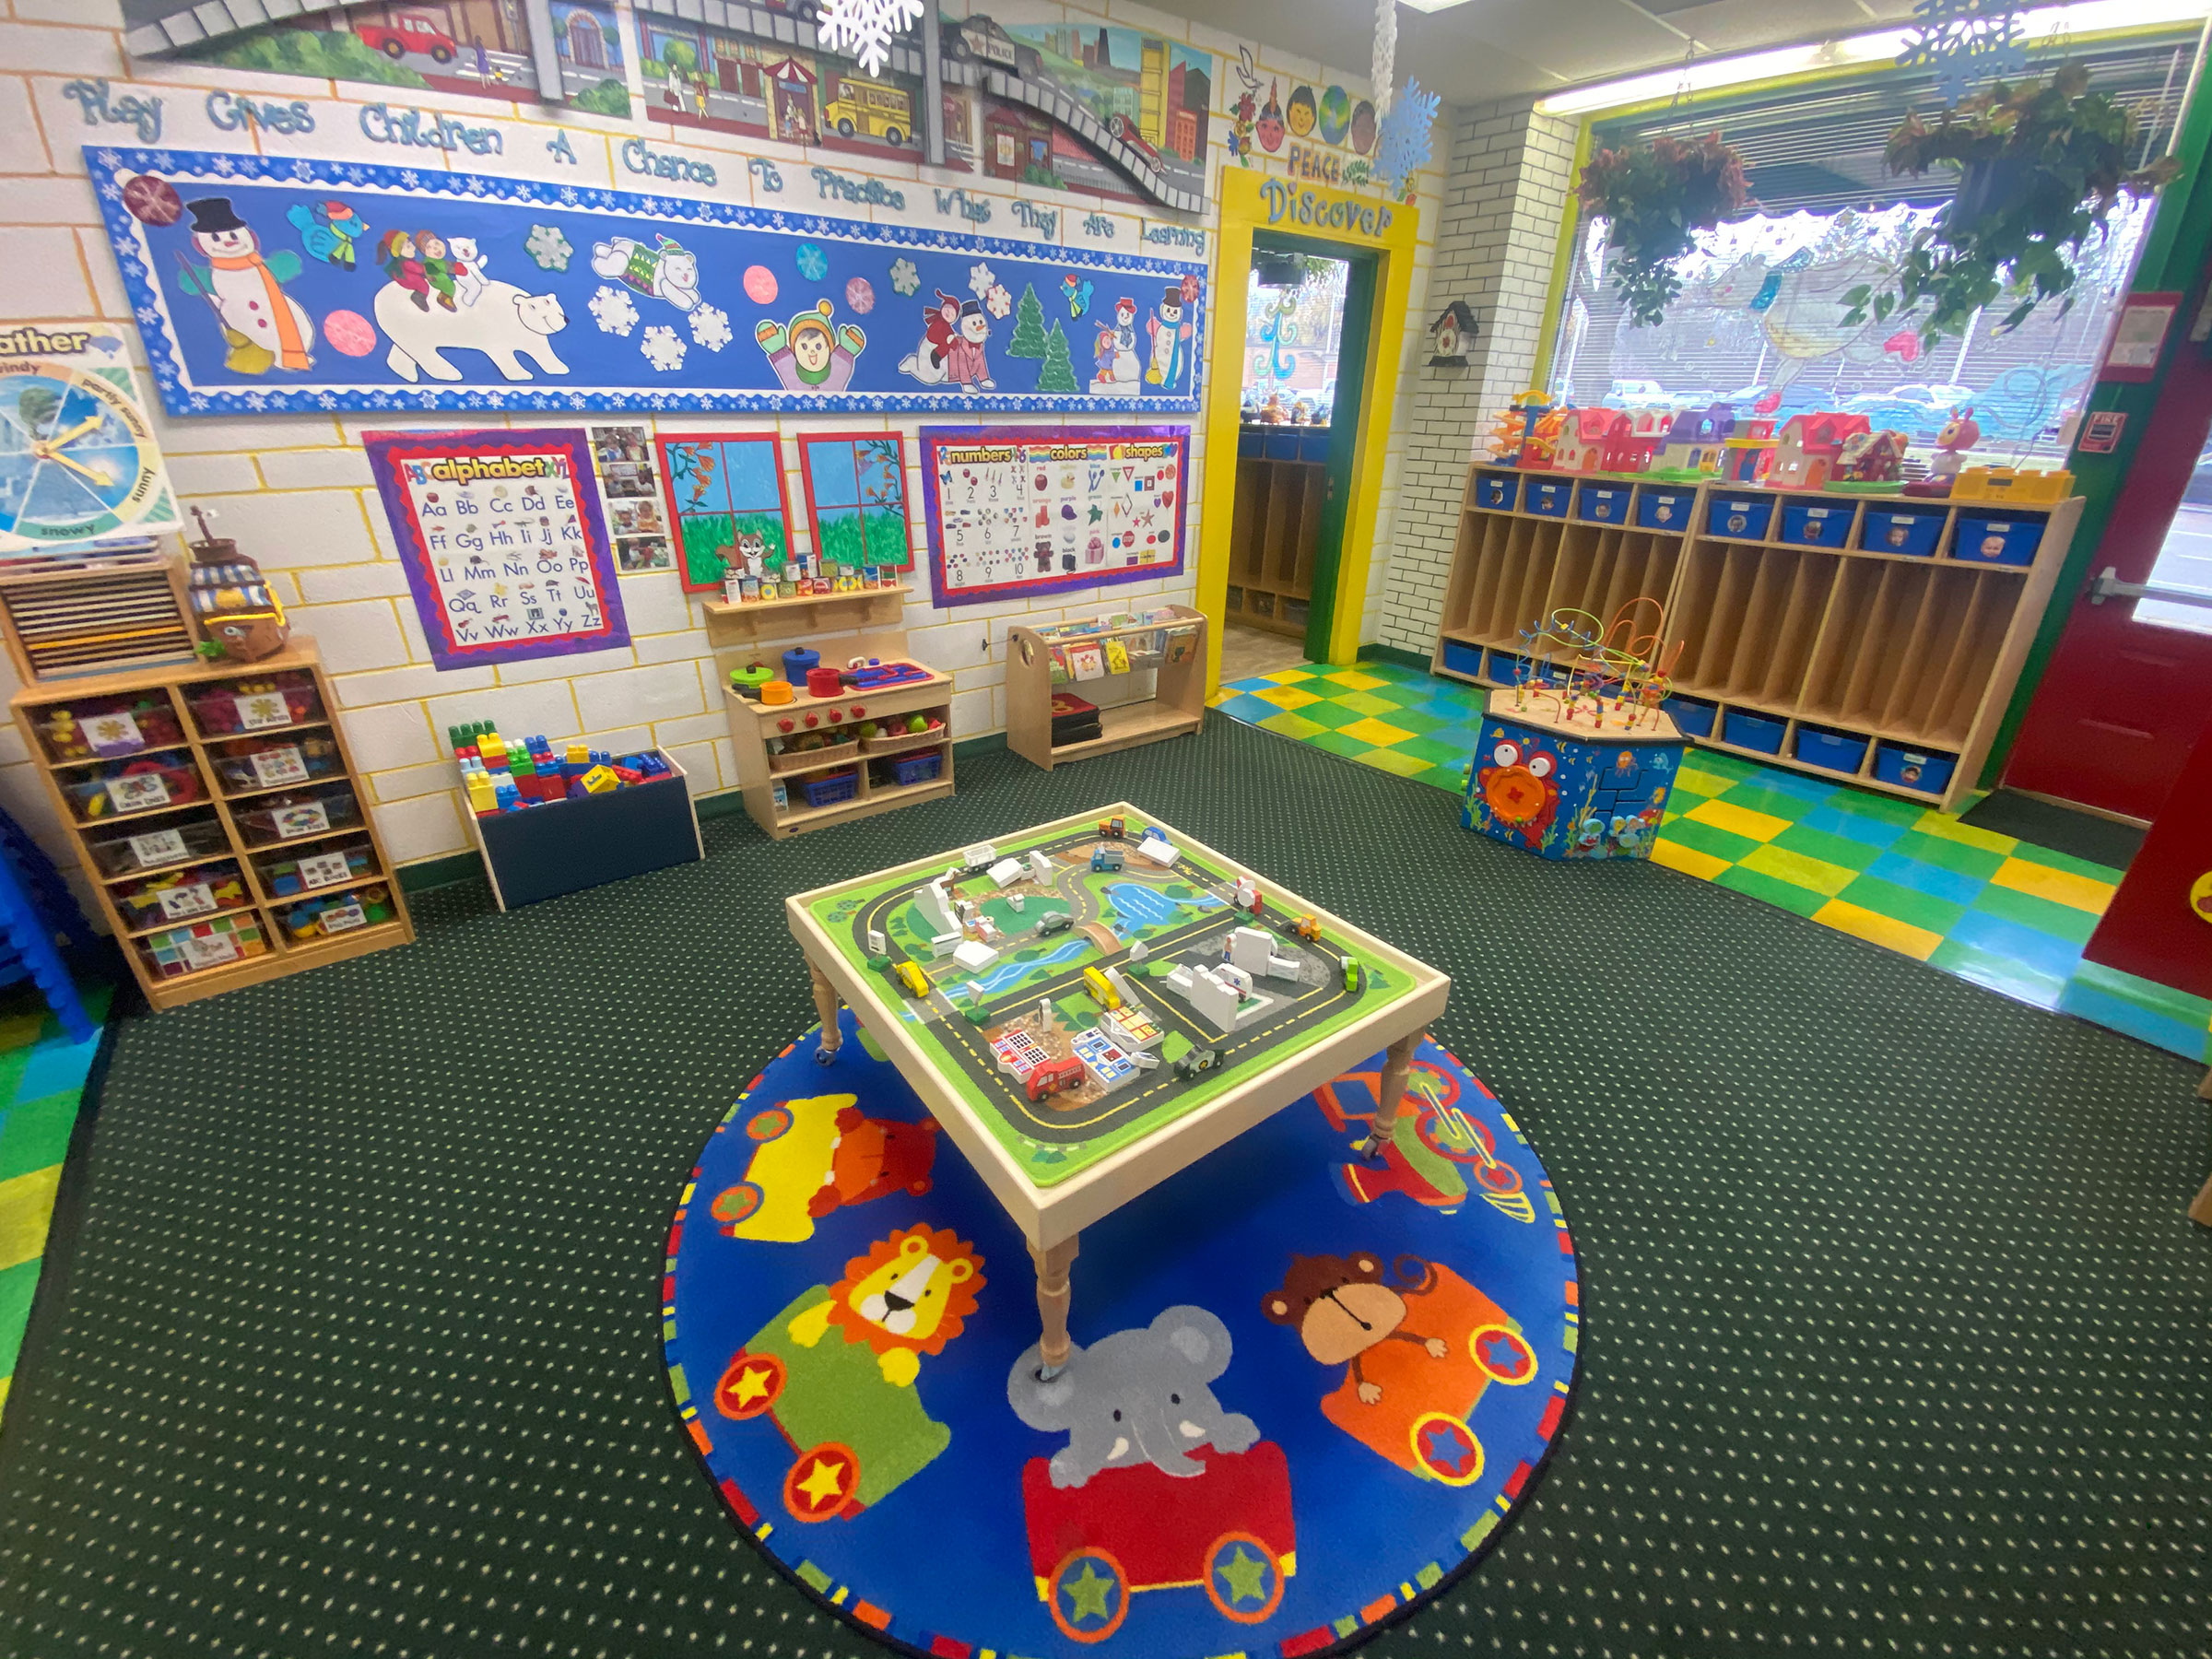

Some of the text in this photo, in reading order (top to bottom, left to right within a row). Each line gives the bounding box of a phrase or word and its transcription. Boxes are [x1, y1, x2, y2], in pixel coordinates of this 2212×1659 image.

[988, 41, 1014, 61] POLICE
[63, 76, 1206, 257] Play Gives Children A Chance To Practice What They Are Learning
[1288, 142, 1340, 182] PEACE
[1260, 178, 1394, 237] Discover
[81, 378, 147, 439] partly sunny
[2093, 414, 2120, 424] FIRE
[950, 445, 1013, 465] numbers
[1050, 443, 1088, 462] colors
[1125, 442, 1163, 462] shapes
[430, 456, 547, 486] alphabet
[132, 466, 156, 503] sunny
[947, 488, 951, 500] 1
[968, 486, 975, 500] 2
[990, 485, 997, 499] 3
[1016, 484, 1023, 496] 4
[421, 495, 575, 517] Aa Bb Cc Dd Ee
[41, 524, 96, 537] snowy
[429, 526, 582, 552] Ff Gg Hh Ii Jj Kk
[957, 529, 963, 542] 5
[984, 527, 991, 539] 6
[1013, 524, 1019, 537] 7
[465, 565, 497, 582] Mm
[503, 561, 529, 577] Nn
[536, 559, 563, 574] Oo
[569, 557, 589, 574] Pp
[957, 570, 963, 582] 8
[985, 566, 992, 578] 9
[1015, 562, 1024, 575] 10
[449, 586, 595, 615] Qq Rr Ss Tt Uu
[455, 614, 602, 643] Vv Ww Xx Yy Zz
